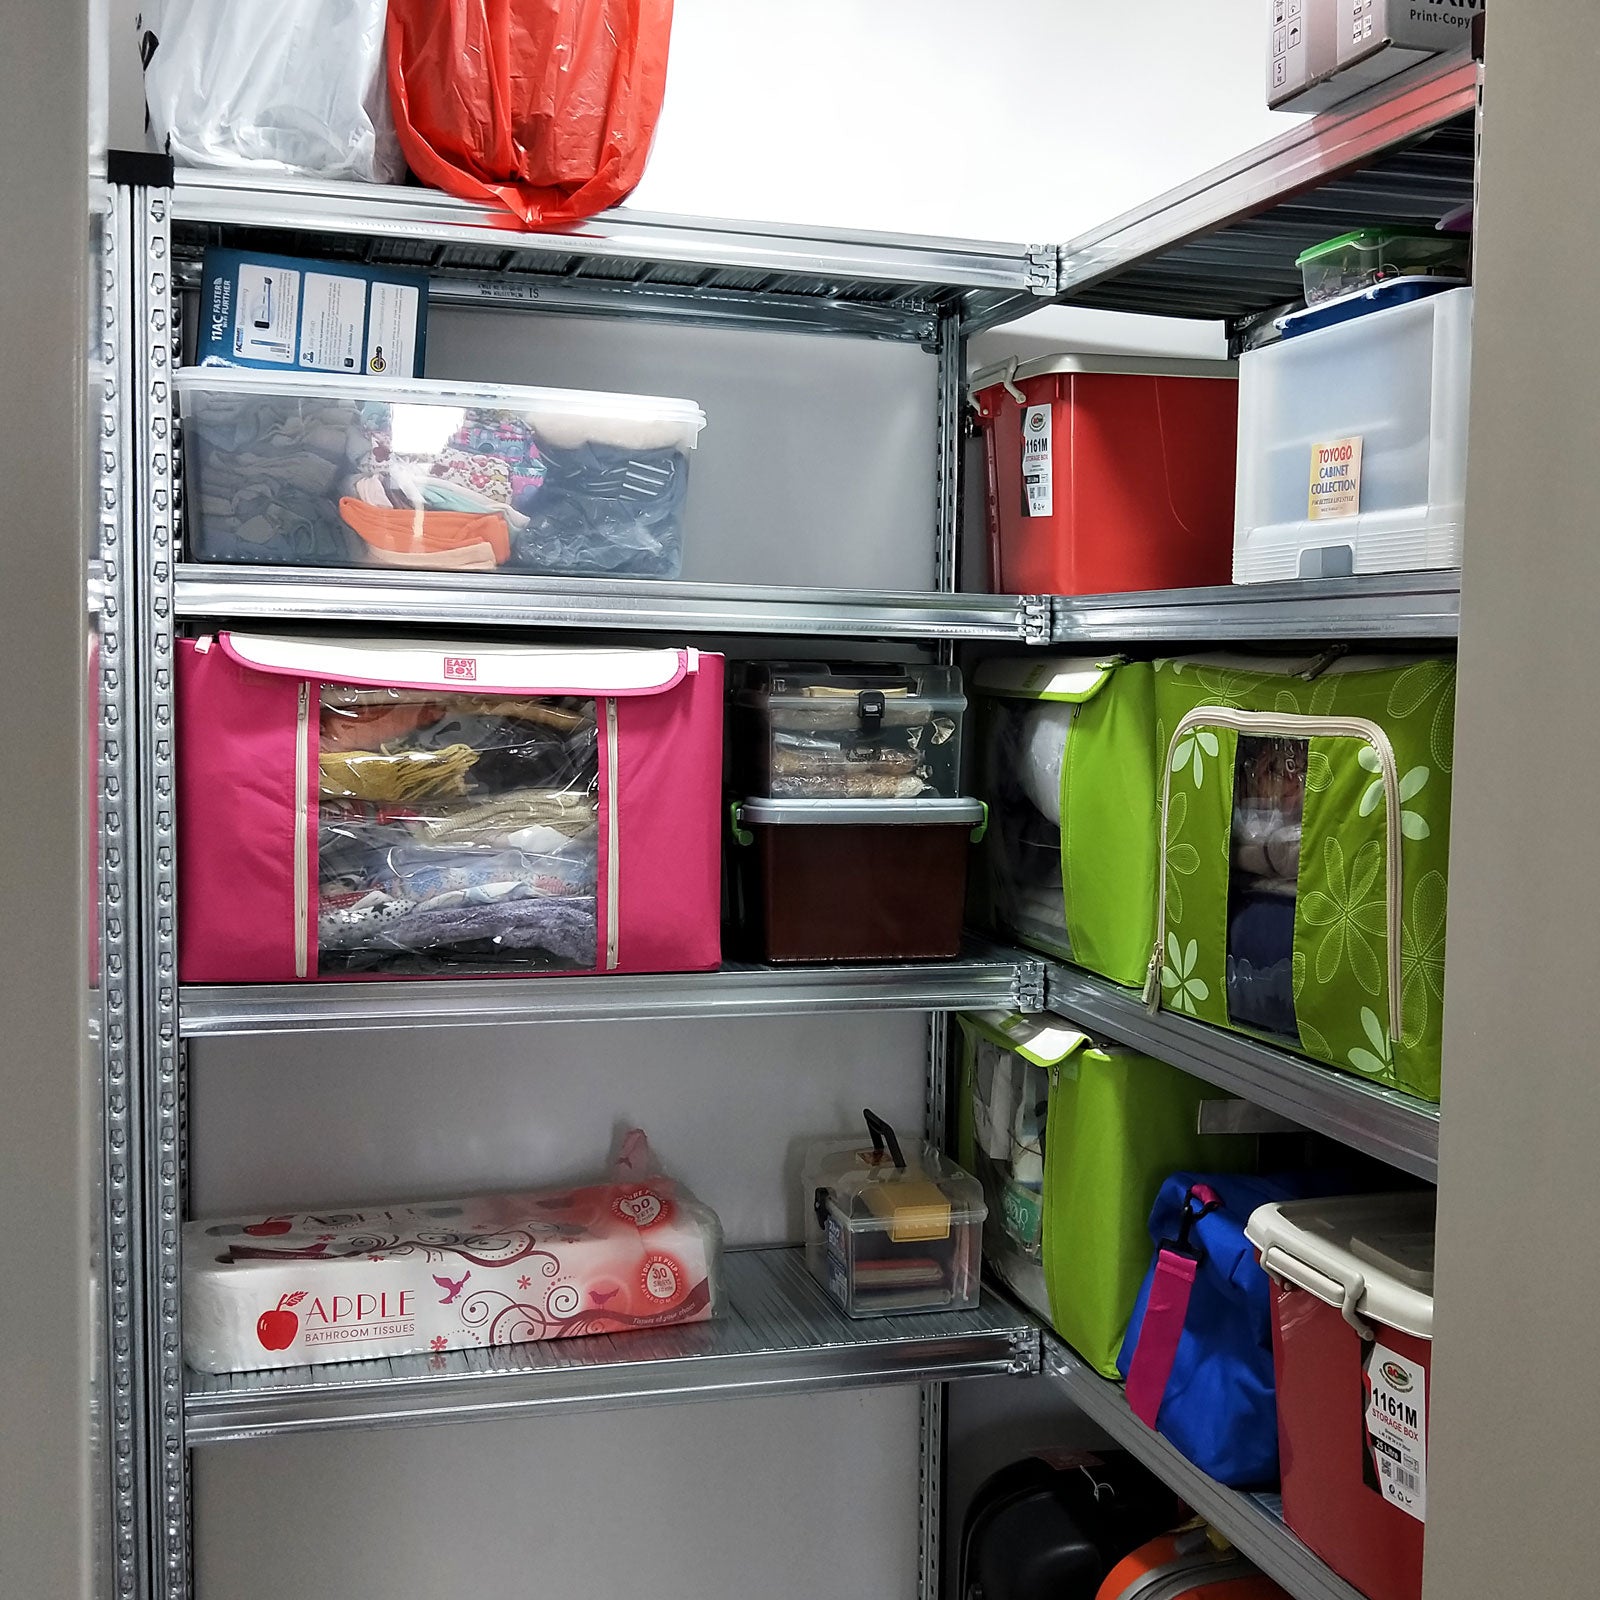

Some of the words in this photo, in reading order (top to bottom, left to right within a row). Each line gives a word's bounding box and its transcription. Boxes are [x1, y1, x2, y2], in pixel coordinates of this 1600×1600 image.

[1277, 63, 1282, 74] 5
[212, 285, 222, 314] FASTER
[222, 280, 231, 315] FURTHER
[211, 314, 224, 342] 11AC
[1026, 438, 1048, 453] 1161M
[1318, 445, 1353, 463] TOYOGO
[1319, 464, 1349, 479] CABINET
[1311, 479, 1356, 495] COLLECTION
[446, 659, 474, 668] EASY
[305, 1289, 415, 1326] APPLE
[305, 1325, 370, 1343] BATHROOM
[372, 1323, 415, 1337] TISSUES
[1372, 1387, 1418, 1429] 1161M
[1371, 1407, 1403, 1433] STORAGE
[1403, 1426, 1419, 1442] BOX
